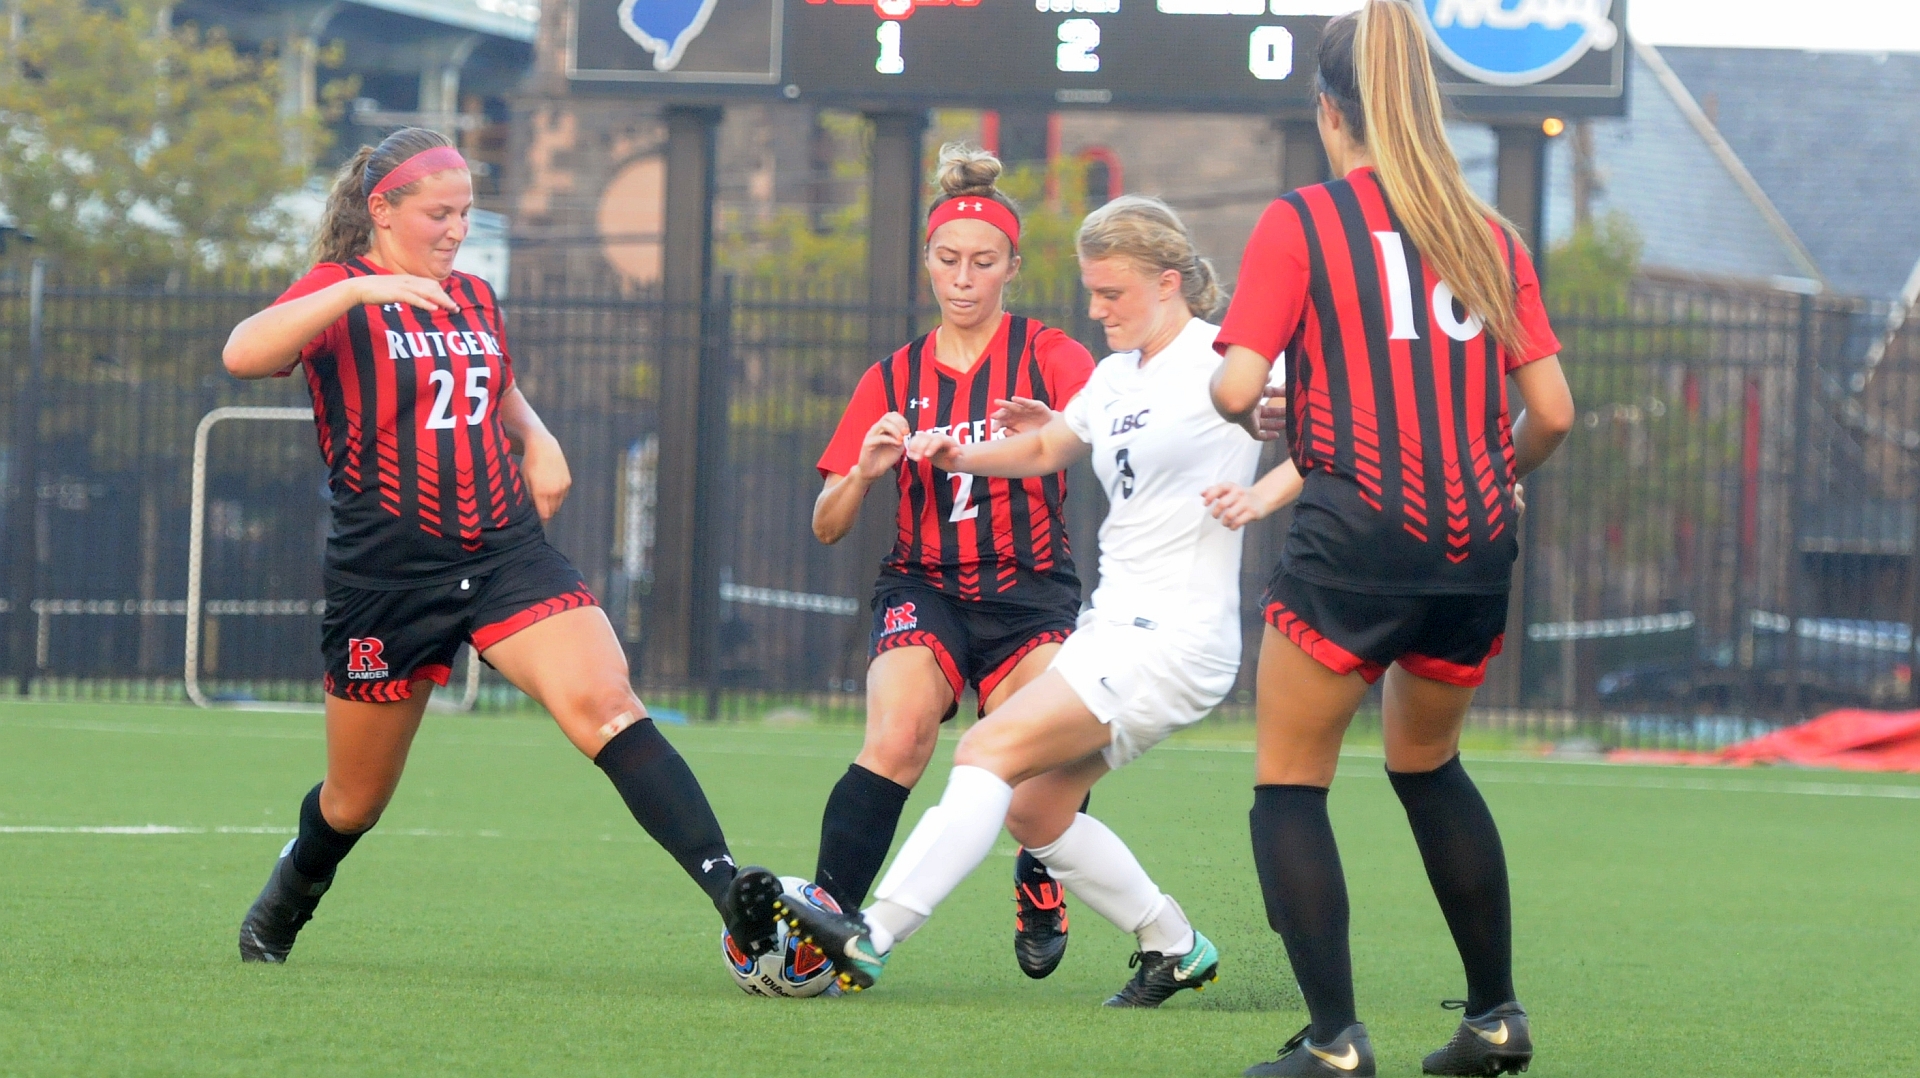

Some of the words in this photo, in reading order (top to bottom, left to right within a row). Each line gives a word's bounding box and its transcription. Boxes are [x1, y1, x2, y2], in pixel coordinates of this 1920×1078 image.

[875, 20, 905, 74] 1
[1056, 18, 1101, 72] 2
[1249, 25, 1293, 80] 0
[425, 366, 491, 430] 25
[1109, 408, 1151, 437] LBC
[946, 471, 980, 523] 2
[346, 636, 389, 672] R
[347, 670, 389, 680] CAMDEN
